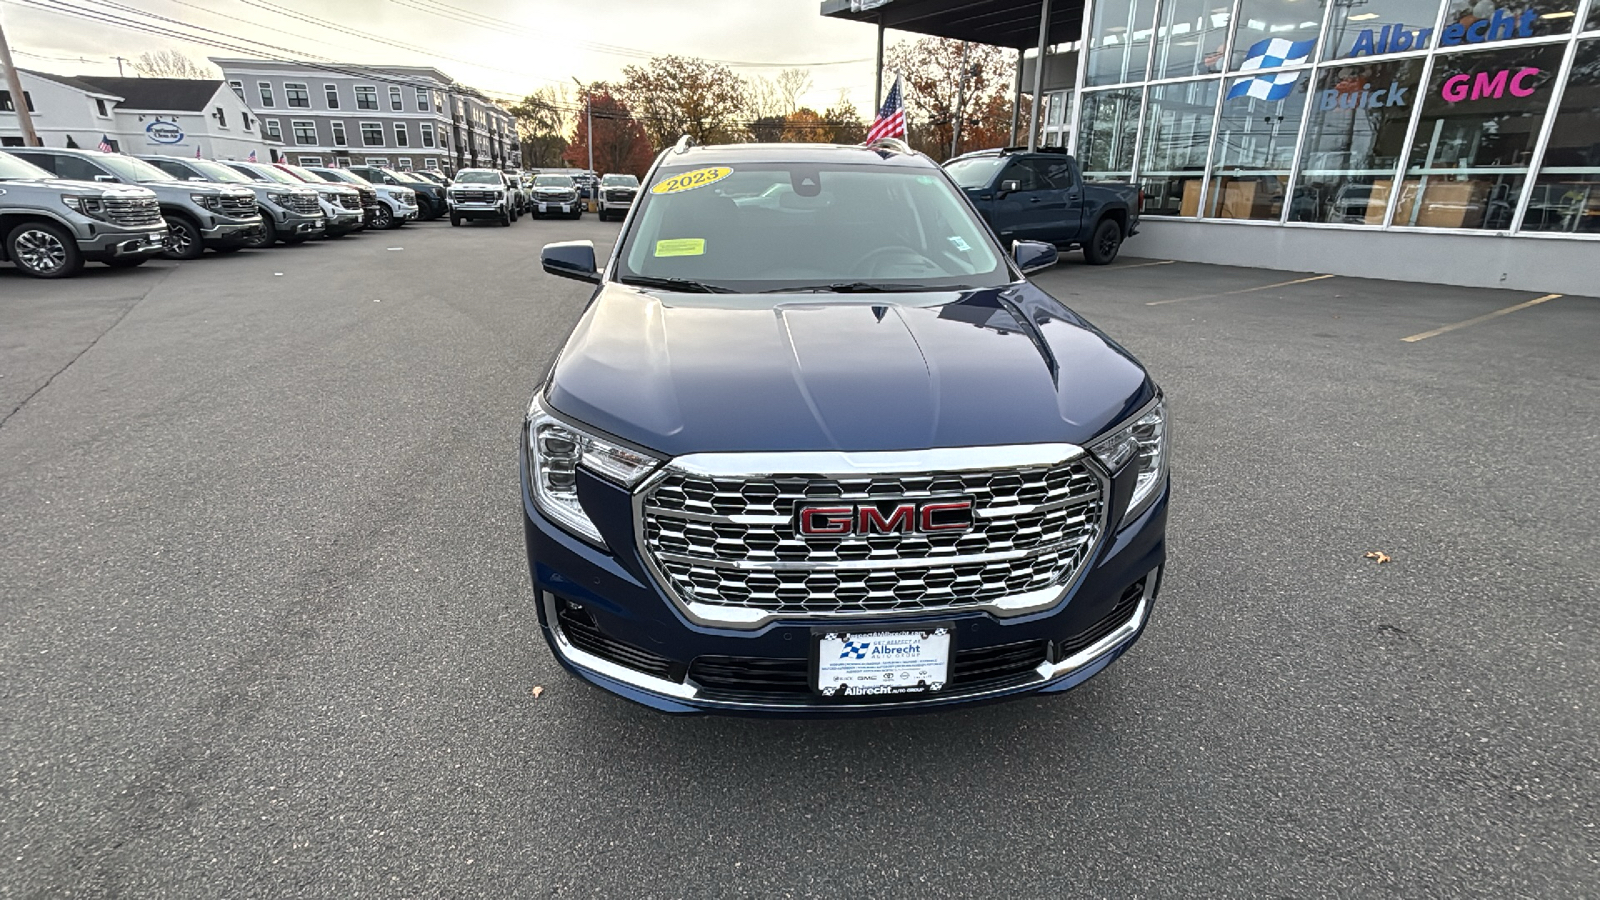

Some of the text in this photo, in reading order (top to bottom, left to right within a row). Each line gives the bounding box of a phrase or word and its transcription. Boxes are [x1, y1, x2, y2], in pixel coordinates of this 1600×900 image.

[1350, 8, 1538, 57] Albrecht
[1320, 67, 1540, 111] Buick GMC
[666, 169, 719, 191] 2023
[799, 501, 972, 536] GMC
[872, 644, 921, 655] Albrecht
[844, 686, 892, 696] Albrecht
